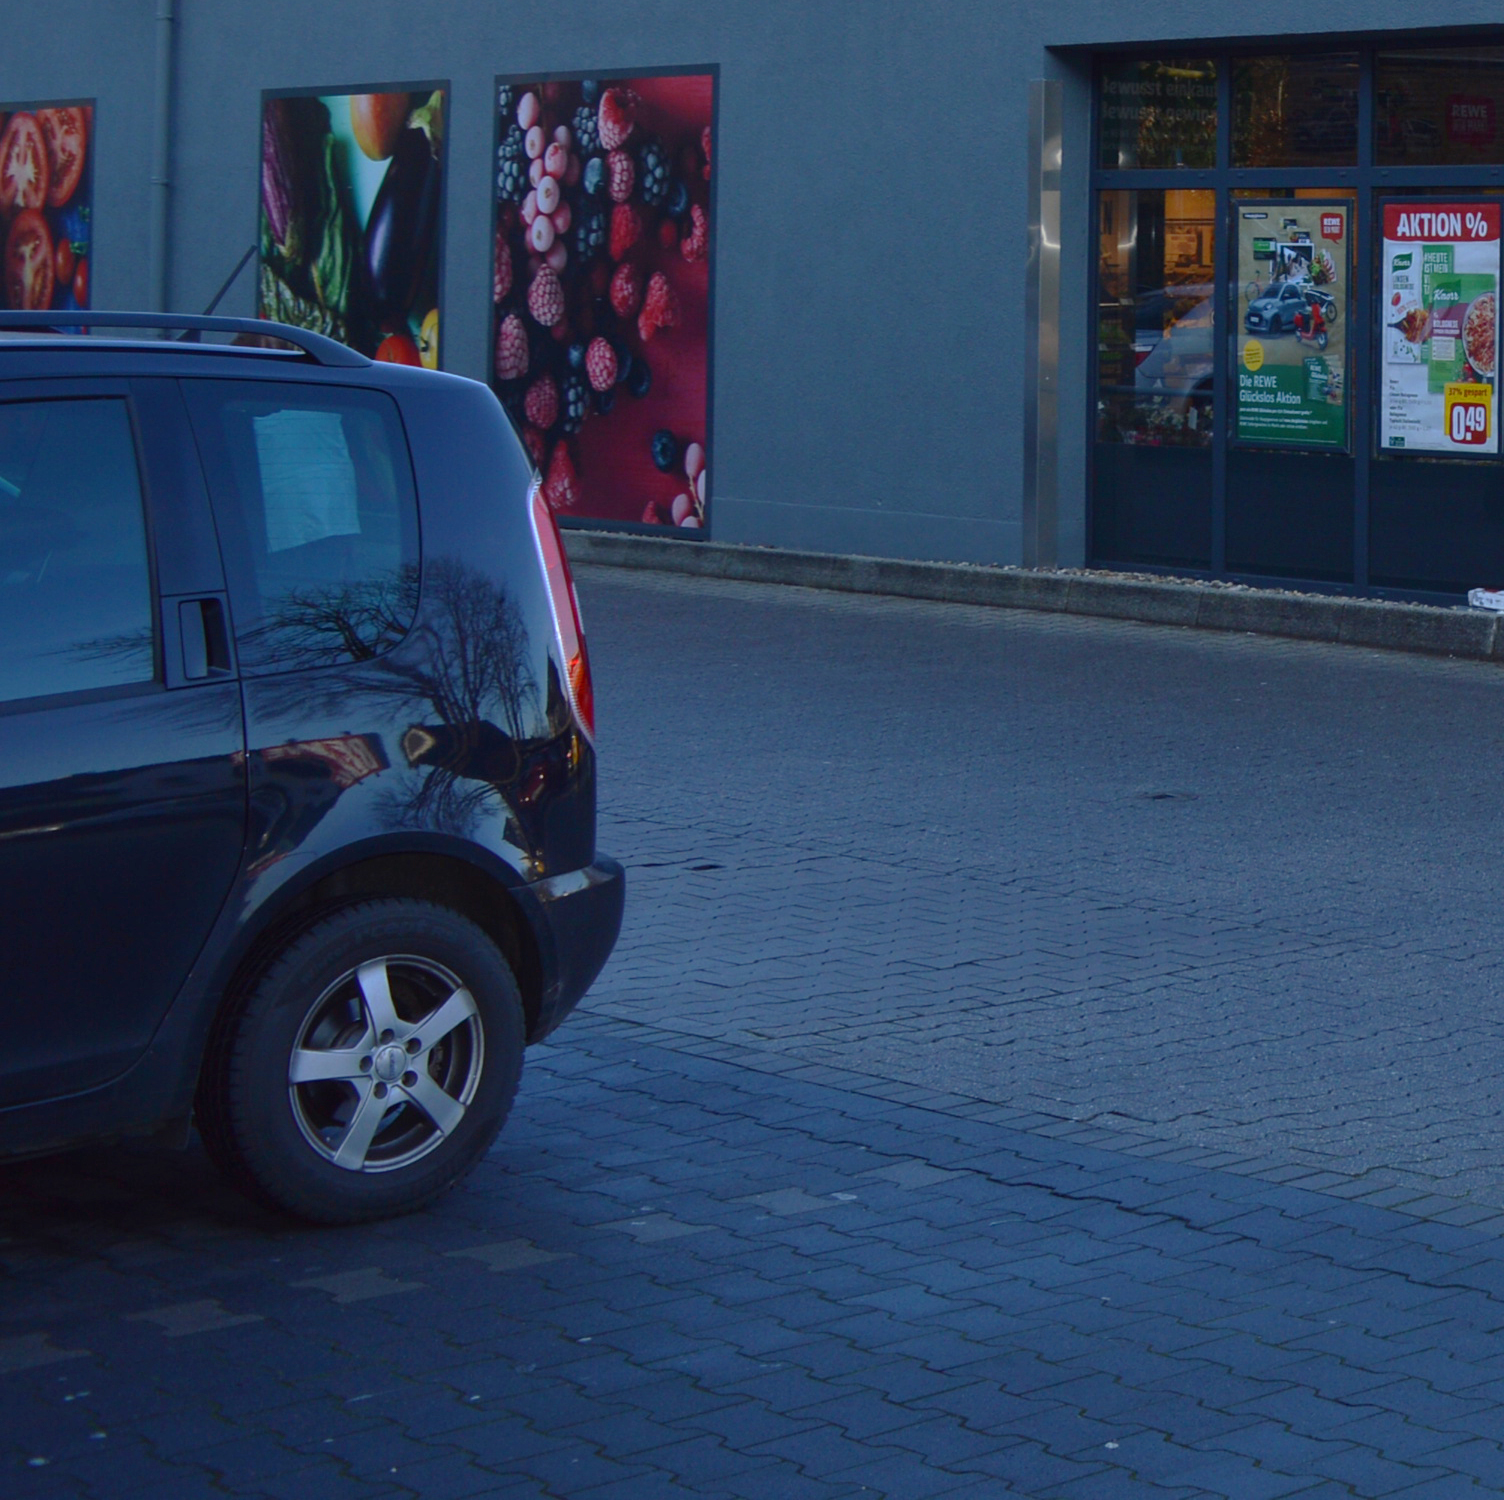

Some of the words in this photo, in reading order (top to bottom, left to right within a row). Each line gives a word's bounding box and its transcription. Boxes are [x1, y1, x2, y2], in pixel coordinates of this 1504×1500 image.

[1396, 212, 1462, 237] AKTION
[1465, 211, 1488, 238] %
[1433, 288, 1459, 301] Knorr
[1239, 374, 1253, 388] Die
[1253, 375, 1278, 388] REWE
[1239, 389, 1275, 404] Glückslos
[1276, 391, 1302, 405] Aktion
[1463, 387, 1488, 398] gespart
[1452, 405, 1486, 441] 0.49
